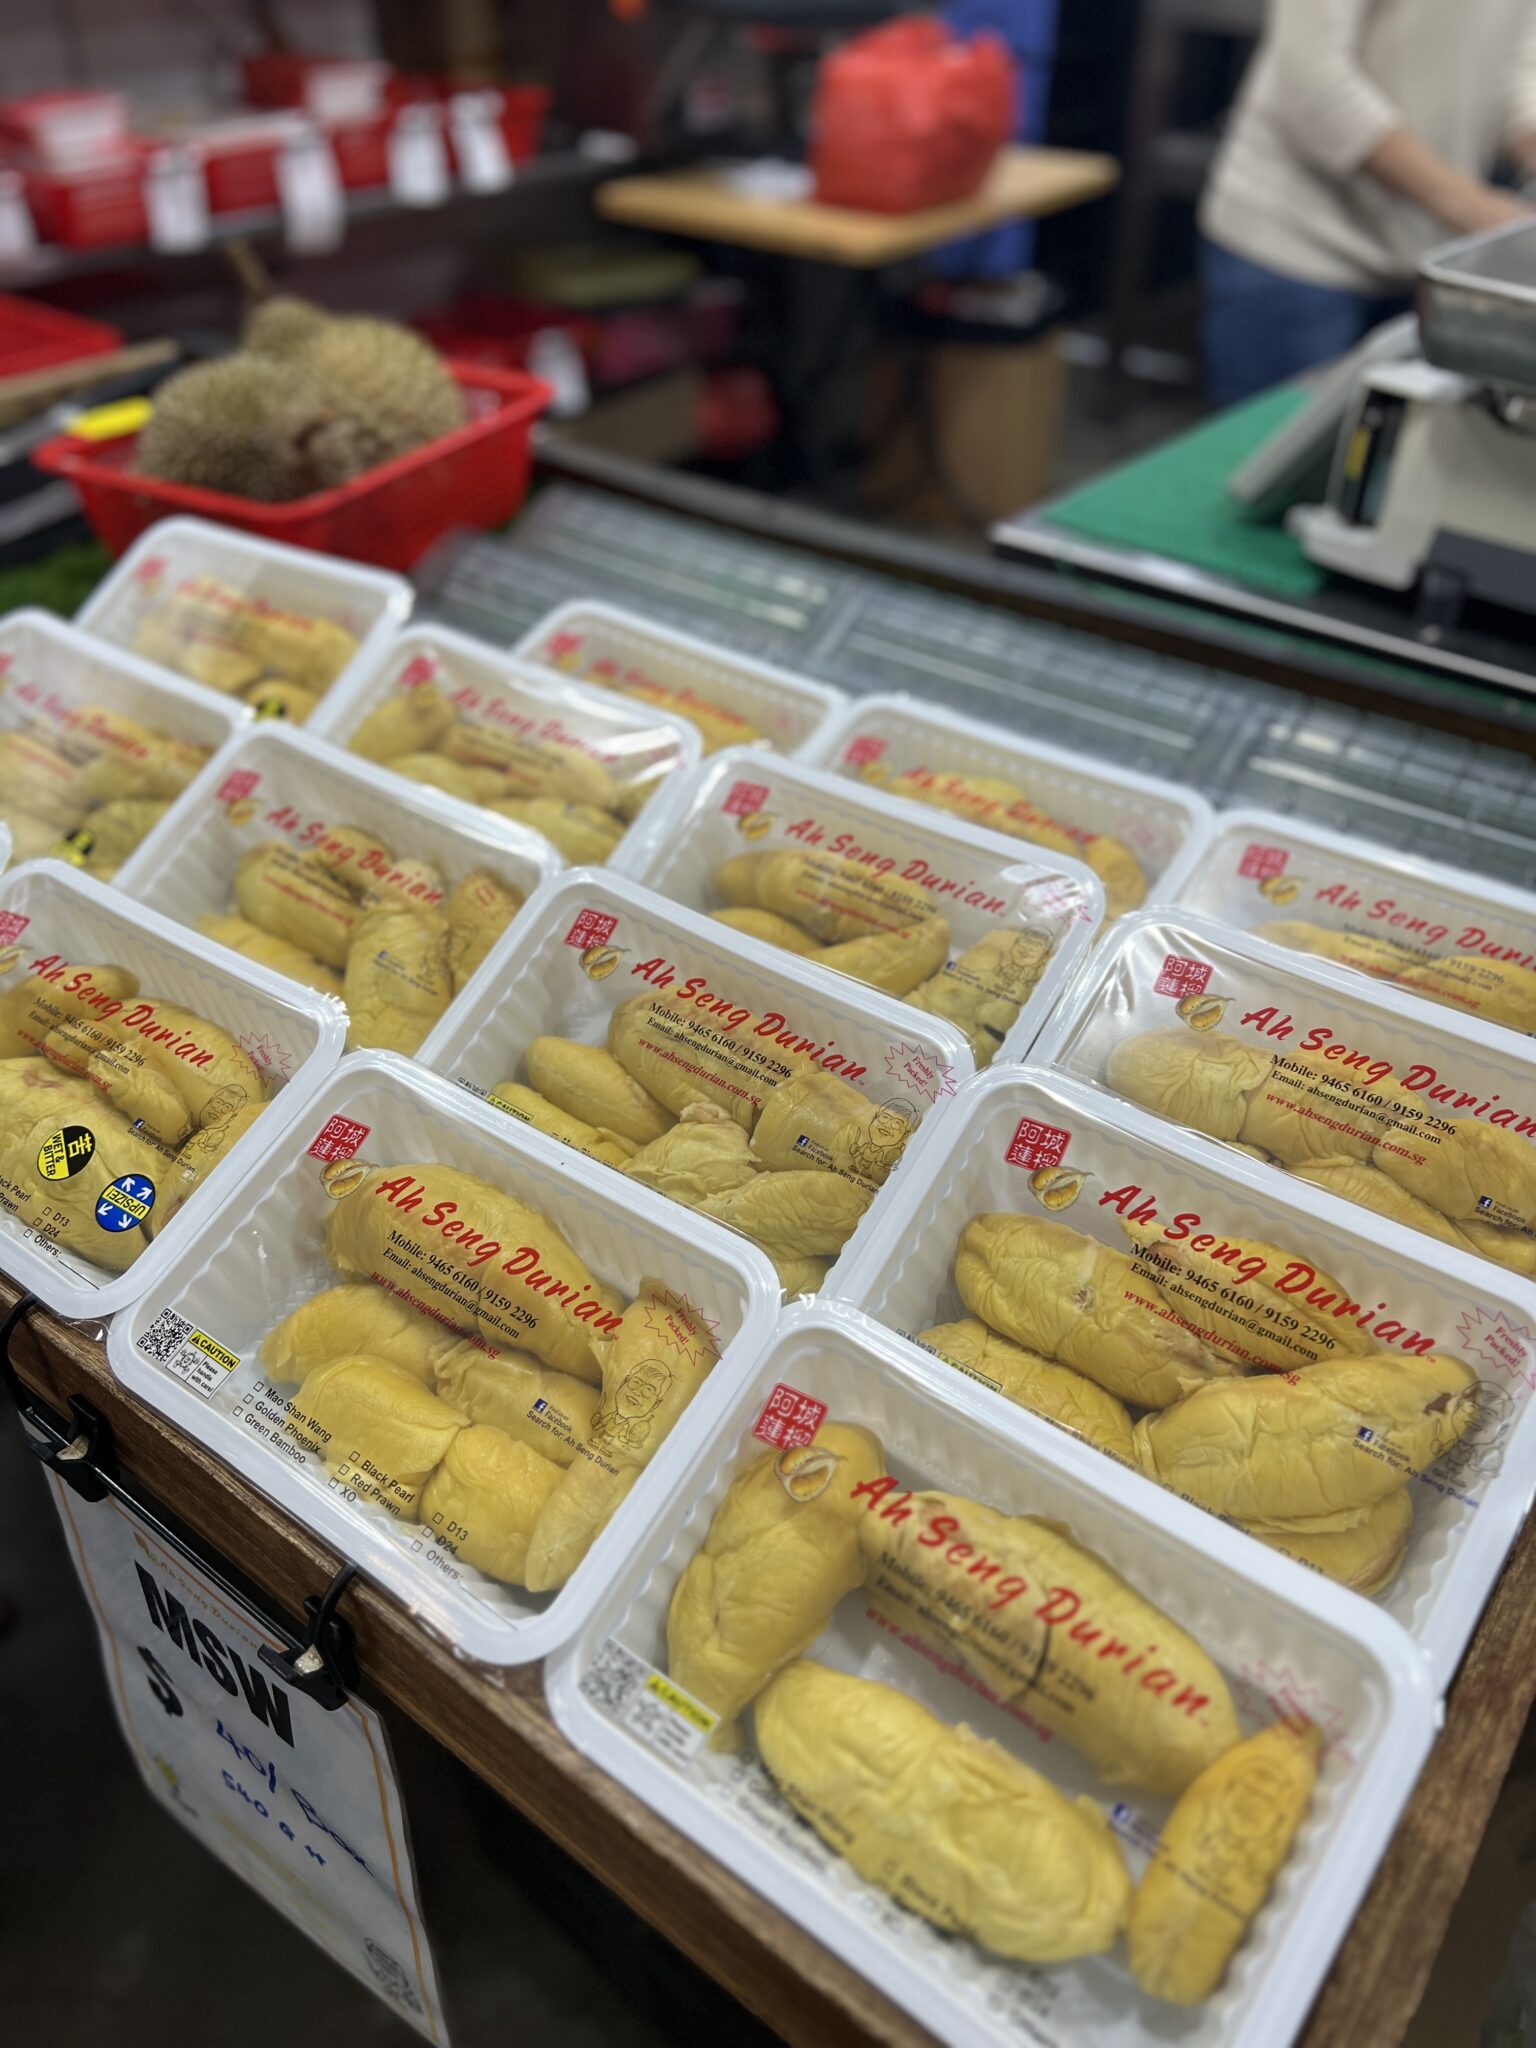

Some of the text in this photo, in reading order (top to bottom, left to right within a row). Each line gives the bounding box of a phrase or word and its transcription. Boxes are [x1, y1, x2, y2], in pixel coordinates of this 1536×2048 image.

[785, 819, 826, 846] Ah
[826, 834, 896, 876] Seng
[900, 859, 1006, 915] Durian
[1316, 883, 1362, 912] Ah
[1367, 899, 1448, 946] Seng
[1455, 926, 1536, 976] Duri
[28, 955, 215, 1068] Ah Seng Durian
[631, 957, 867, 1082] Ah Seng Durian
[64, 1014, 84, 1029] 9465
[81, 1025, 103, 1041] 6160
[106, 1038, 125, 1054] 9159
[124, 1049, 145, 1067] 2296
[647, 1017, 778, 1088] Email: ahsengdurian@gmail.com
[648, 1002, 793, 1079] Mobile: 9465 6160 9159 2296
[638, 1038, 763, 1107] www.ahsengdurian.com.sg
[904, 1062, 928, 1087] Packed!
[913, 1056, 935, 1080] Freshly
[1240, 1006, 1536, 1138] Ah Seng Durian
[1270, 1054, 1458, 1135] Mobile: 9465 6160 9159 2296
[1271, 1070, 1442, 1145] Email: ahsengdurian@gmail.com
[52, 1133, 63, 1154] WET
[128, 1127, 145, 1142] Search
[163, 1150, 177, 1162] Seng
[177, 1158, 195, 1172] Durian
[324, 1117, 366, 1147] 阿城
[1018, 1121, 1065, 1154] 阿城
[1265, 1092, 1427, 1166] www.ahsengdurian.com.sg
[43, 1145, 56, 1177] BITTER
[792, 1145, 815, 1160] Search
[827, 1164, 838, 1173] Ah
[838, 1169, 856, 1184] Seng
[856, 1179, 879, 1194] Durian
[808, 1145, 833, 1161] Facebook
[11, 1185, 31, 1202] Pearl
[105, 1187, 145, 1217] UPSIZE!
[1474, 1206, 1503, 1222] Search
[1493, 1206, 1525, 1223] Facebook
[43, 1223, 60, 1238] D24
[53, 1212, 70, 1227] D13
[34, 1234, 62, 1257] Others:
[375, 1176, 623, 1335] Ah Seng Durian
[387, 1230, 541, 1329] Mobile: 9465 6160 9159 2296
[1099, 1185, 1436, 1356] Ah Seng Durian
[371, 1271, 501, 1361] www.ahsengdurian.com.sg
[382, 1248, 520, 1340] Email: ahsengdurian@gmail.com
[1130, 1244, 1336, 1351] Mobile: 9465 6160 9159 2296
[1130, 1262, 1319, 1361] Email: ahsengdurian@gmail.com
[664, 1314, 690, 1345] Packed!
[675, 1307, 698, 1337] Freshly
[1123, 1290, 1301, 1386] www.ahsengdurian.com.sg
[1495, 1326, 1528, 1358] Freshly
[200, 1340, 236, 1368] CAUTION
[1484, 1333, 1521, 1368] Packed!
[255, 1401, 321, 1455] Golden Phoenix
[265, 1388, 332, 1443] Mao Shan Wang
[545, 1411, 573, 1432] Facebook
[770, 1388, 822, 1429] 阿城
[245, 1413, 306, 1464] Green Bamboo
[527, 1410, 551, 1431] Search
[564, 1436, 575, 1447] Ah
[575, 1442, 594, 1461] Seng
[594, 1456, 620, 1476] Durian
[1352, 1439, 1385, 1461] Search
[1404, 1466, 1418, 1479] Ah
[340, 1486, 357, 1502] XO
[350, 1472, 400, 1515] Red Prawn
[361, 1460, 416, 1503] Black Pearl
[436, 1535, 458, 1555] D24
[446, 1521, 469, 1541] D13
[850, 1476, 913, 1527] Ah
[917, 1516, 1028, 1611] Seng
[1035, 1587, 1211, 1718] Durian
[134, 1560, 295, 1748] MSW
